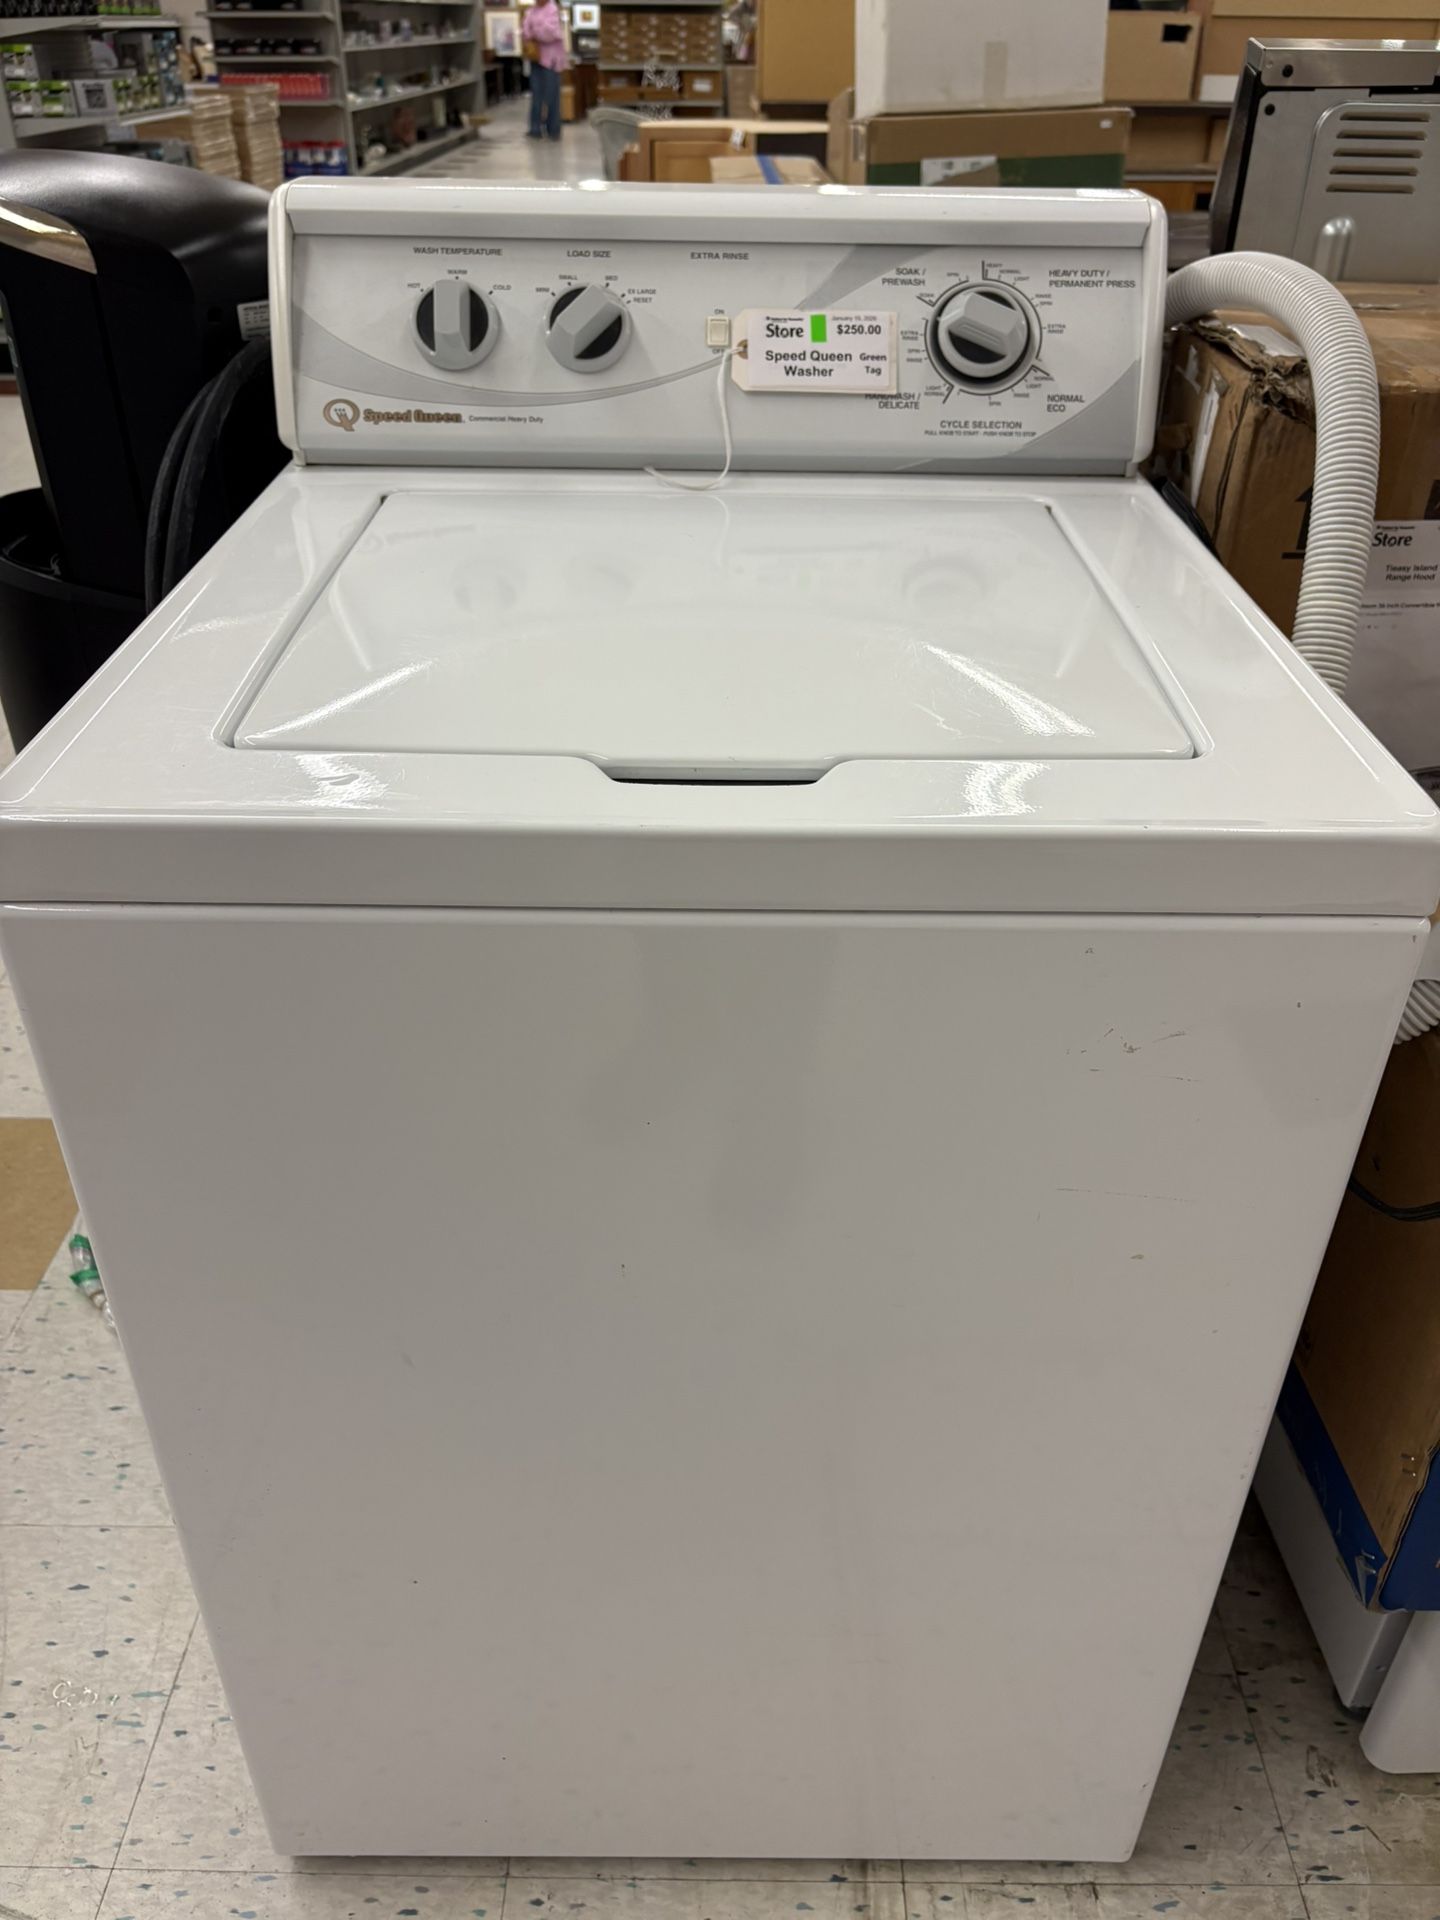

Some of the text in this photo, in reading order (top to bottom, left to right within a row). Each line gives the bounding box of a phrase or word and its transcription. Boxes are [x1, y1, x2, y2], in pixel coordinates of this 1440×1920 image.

[413, 247, 503, 256] WASH TEMPERATURE
[567, 250, 611, 258] LOAD SIZE
[690, 252, 750, 260] EXTRA RINSE
[896, 267, 920, 275] SOAK
[1049, 269, 1079, 277] HEAVY
[1080, 269, 1105, 277] DUTY
[881, 277, 925, 286] PREWASH
[1049, 280, 1136, 288] PERMANENT PRESS
[765, 323, 804, 338] Store
[836, 324, 882, 336] $250.00
[765, 350, 852, 363] Speed Queen
[859, 352, 887, 361] Green
[784, 365, 834, 377] Washer
[864, 365, 882, 375] Tag
[1046, 394, 1085, 403] NORMAL
[878, 401, 920, 410] DELICATE
[1046, 404, 1066, 413] ECO
[363, 408, 462, 425] Speed Queen
[507, 416, 527, 424] Heavy
[529, 416, 544, 424] Duty
[940, 420, 1022, 430] CYCLE SELECTION
[1372, 532, 1413, 547] Store
[1413, 564, 1438, 572] Island
[1386, 574, 1412, 582] Range
